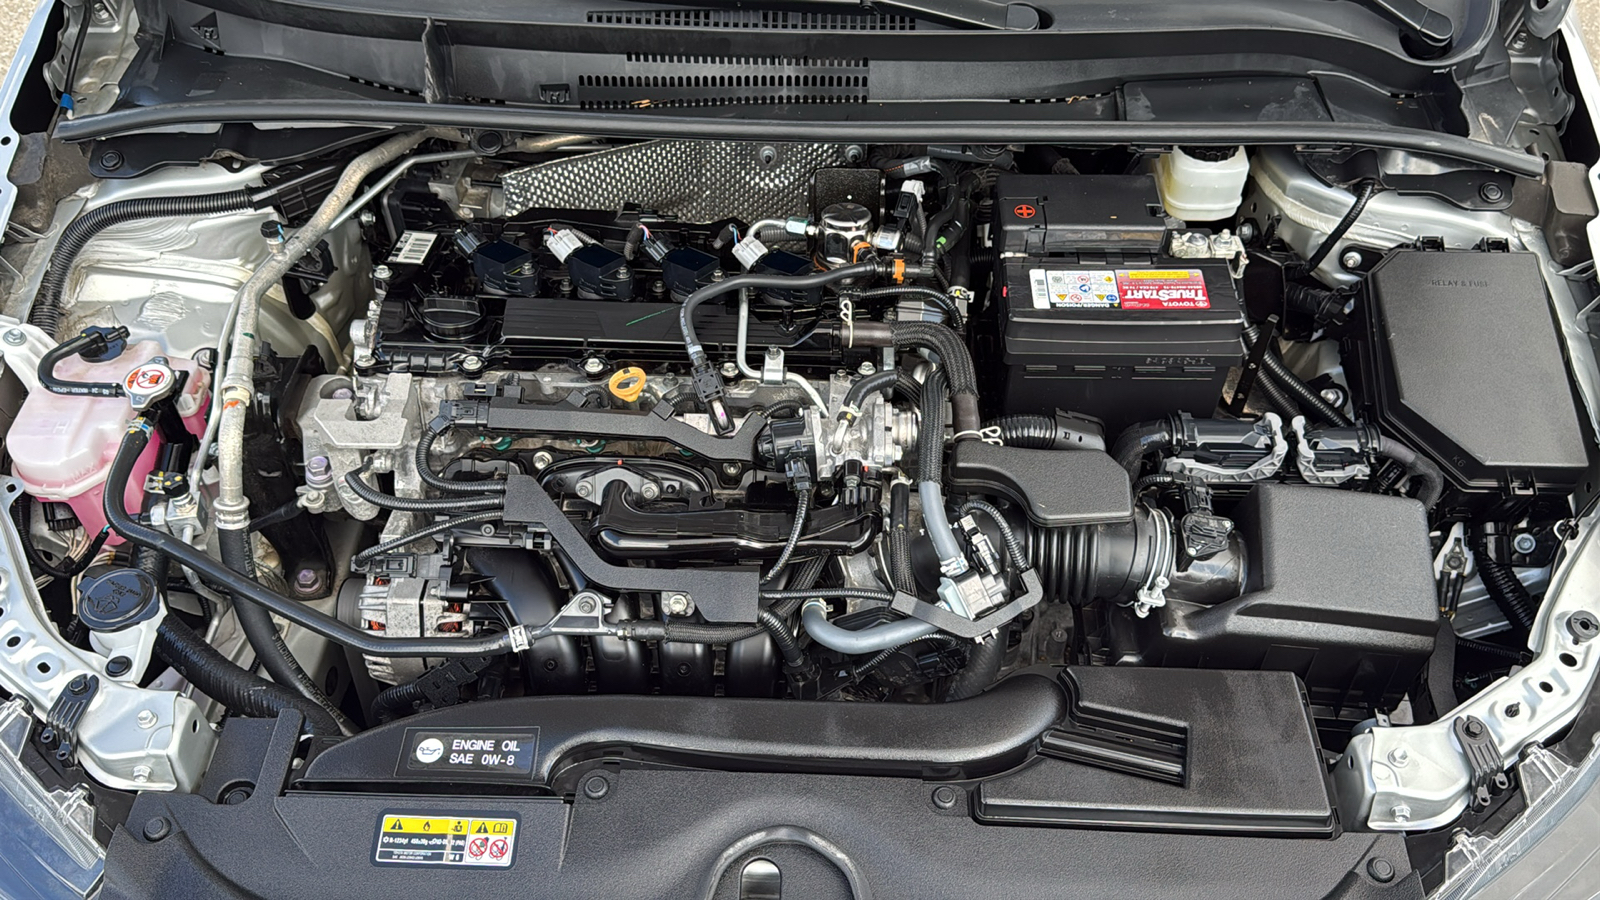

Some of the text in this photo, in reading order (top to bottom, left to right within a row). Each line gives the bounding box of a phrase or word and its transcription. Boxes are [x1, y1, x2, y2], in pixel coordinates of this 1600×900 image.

[1431, 279, 1458, 287] RELAY
[452, 739, 520, 752] ENGINE OIL
[449, 753, 515, 766] SAE 0W-8
